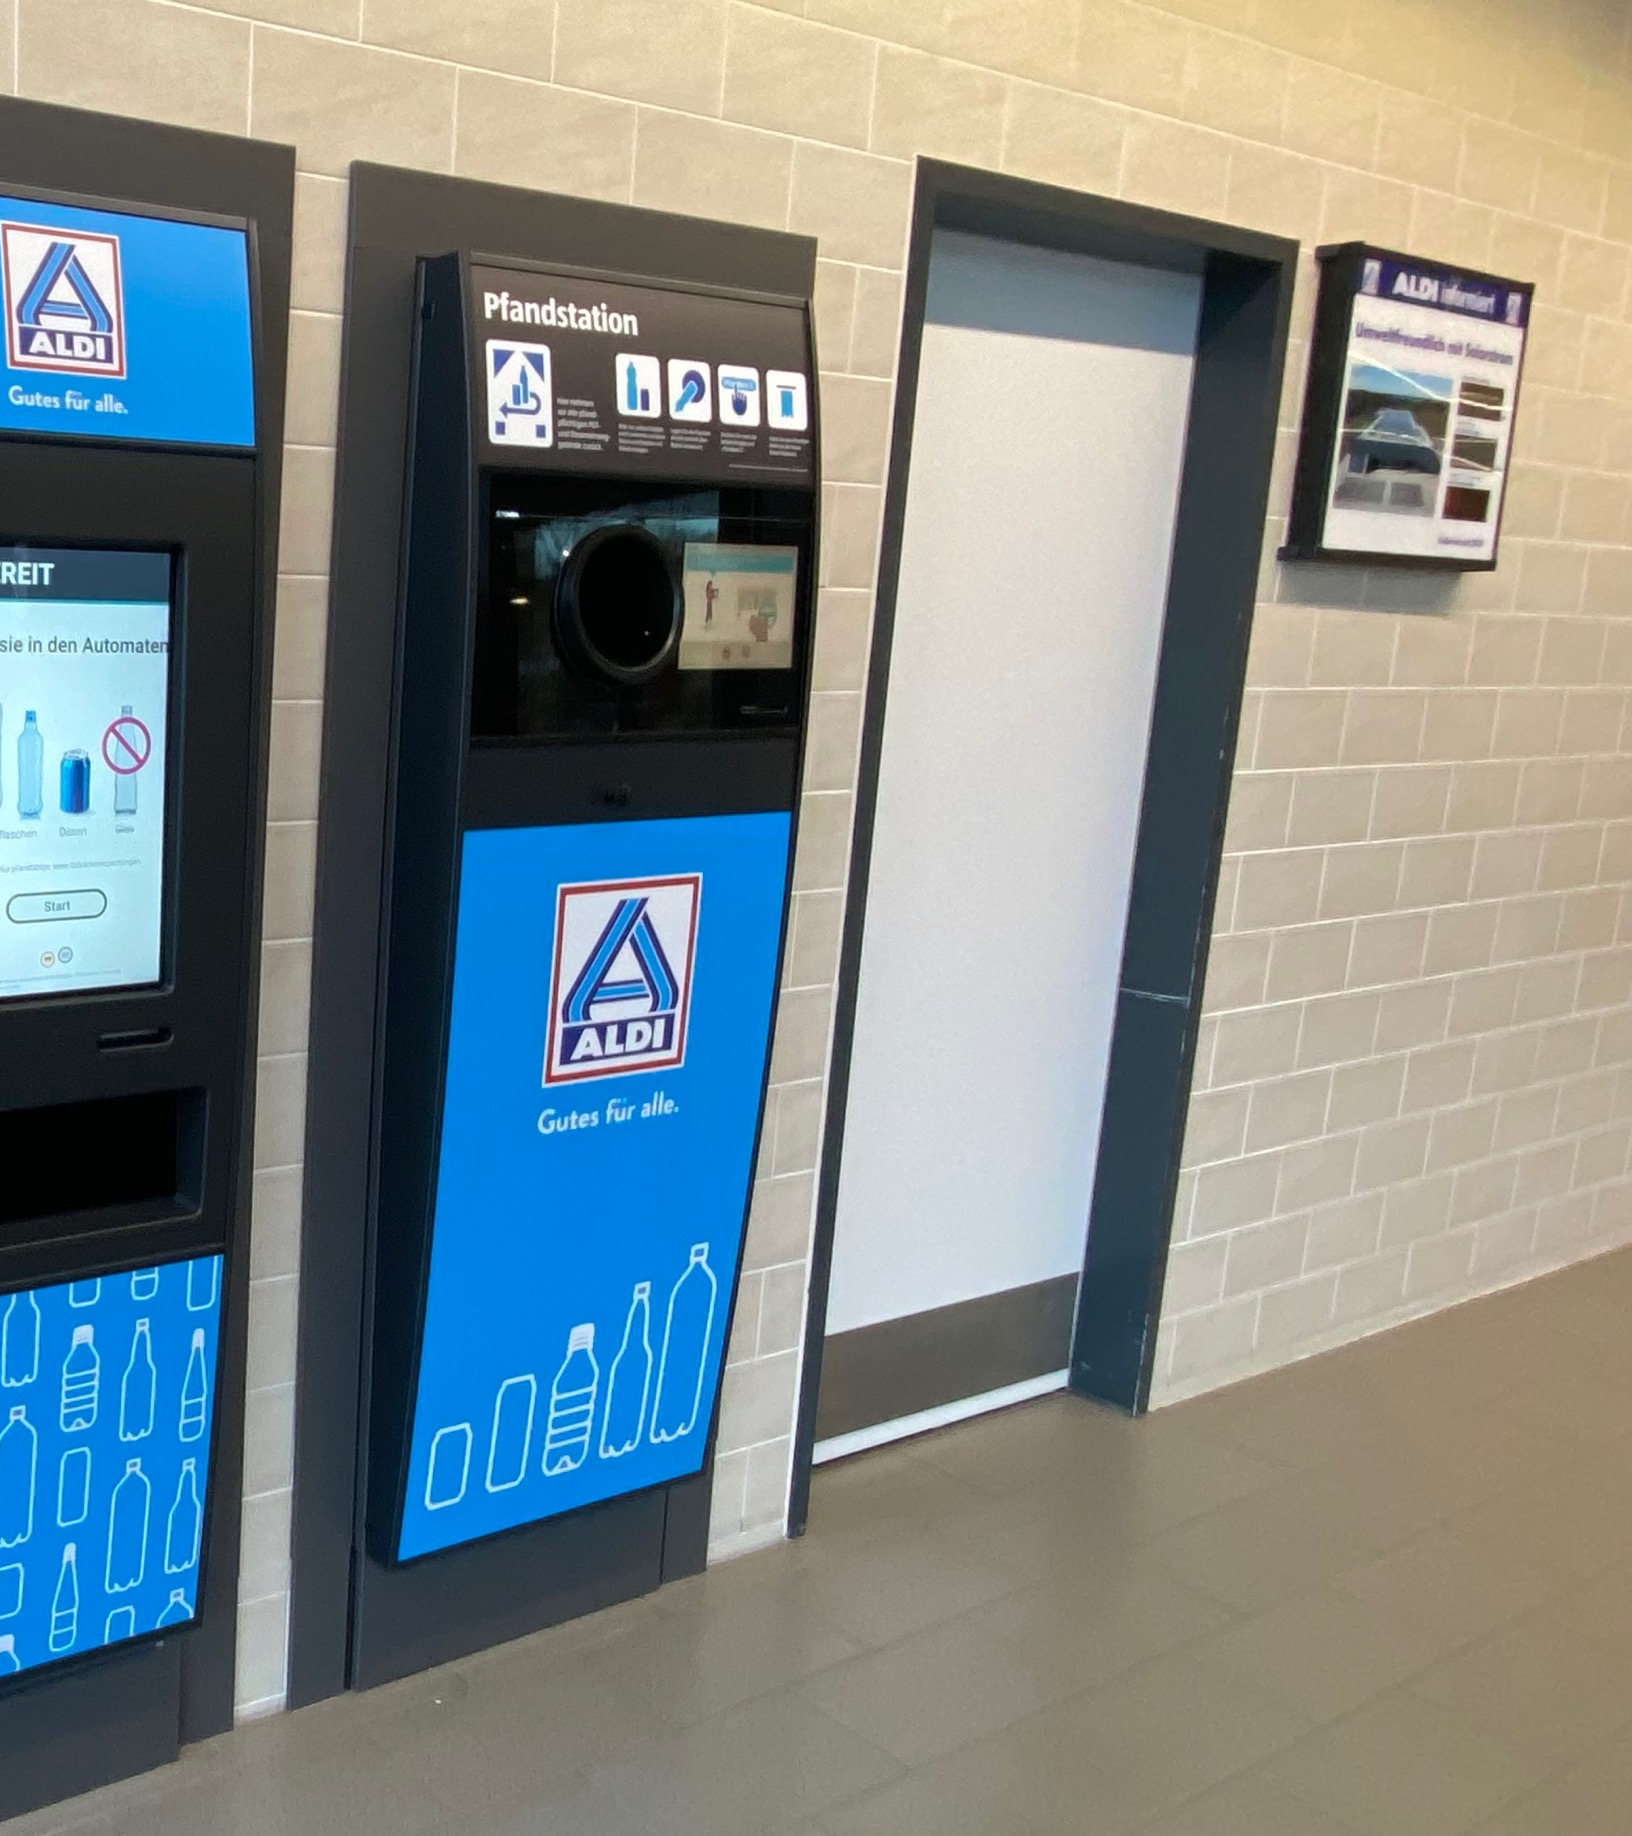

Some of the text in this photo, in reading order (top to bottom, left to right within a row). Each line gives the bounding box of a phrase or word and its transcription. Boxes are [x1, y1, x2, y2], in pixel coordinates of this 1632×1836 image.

[1392, 271, 1438, 303] ALDI
[483, 291, 639, 336] Pfandstation
[29, 332, 106, 360] ALDI
[8, 386, 128, 414] Gutes für alle.
[0, 635, 23, 653] sie
[28, 635, 43, 653] in
[48, 636, 78, 653] den
[82, 637, 169, 653] Automaten
[44, 900, 71, 912] Start
[570, 1019, 665, 1061] ALDI
[537, 1090, 680, 1135] Gutes für alle.
